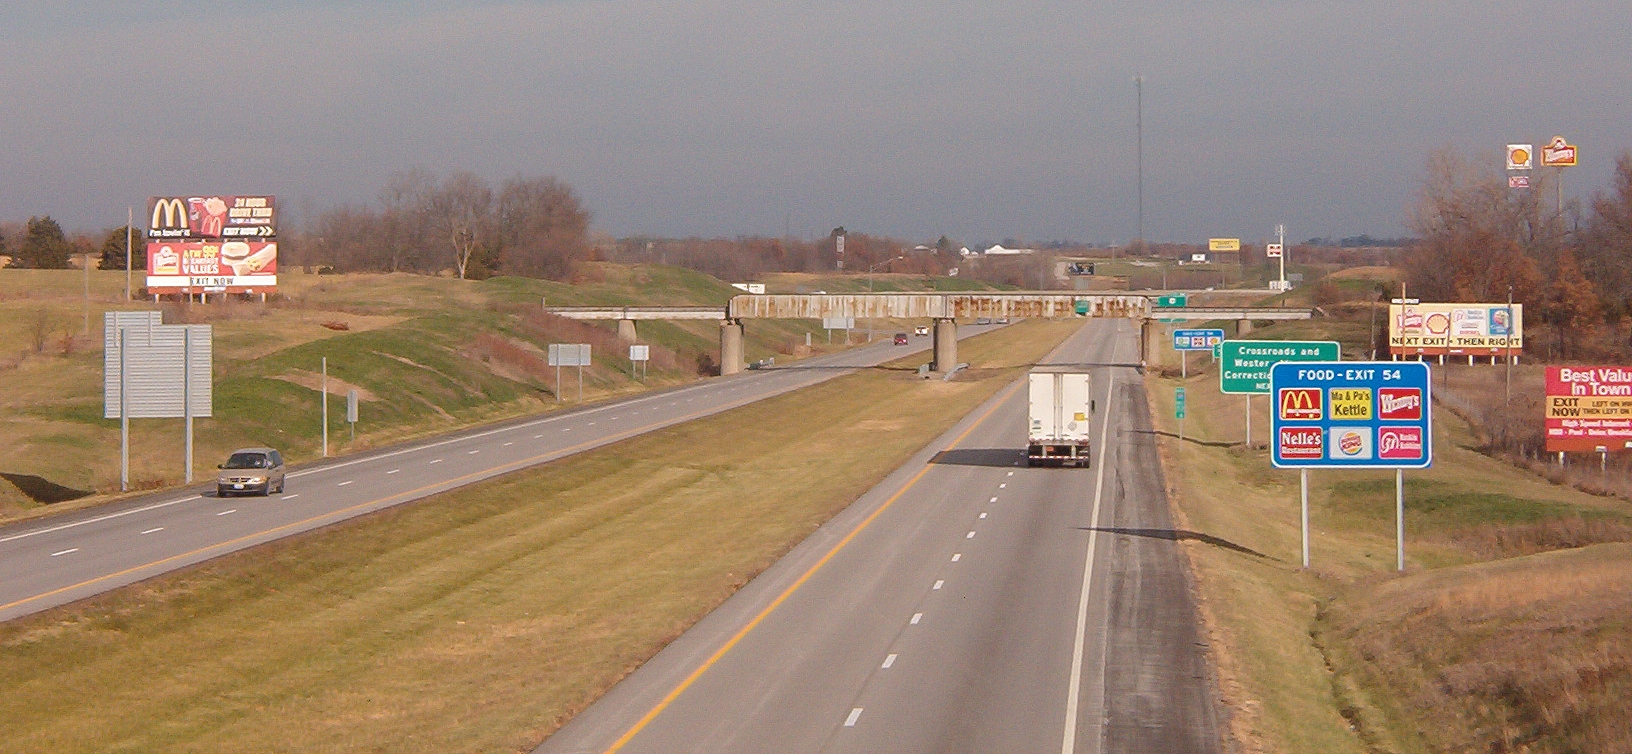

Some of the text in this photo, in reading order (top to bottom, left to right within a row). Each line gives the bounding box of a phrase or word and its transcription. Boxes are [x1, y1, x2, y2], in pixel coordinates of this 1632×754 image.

[182, 264, 219, 274] VALUES
[191, 277, 234, 285] EXIT NOW
[1422, 337, 1446, 345] EXIT
[1457, 337, 1485, 345] THEN
[1238, 346, 1320, 356] Crossroads and
[1234, 359, 1272, 367] Wester
[1298, 369, 1334, 381] FOOD
[1345, 369, 1375, 381] EXIT
[1382, 369, 1401, 381] 54
[1560, 368, 1595, 382] Best
[1571, 382, 1631, 395] In Town
[1331, 391, 1370, 401] Ma & Pa's
[1553, 397, 1579, 407] EXIT
[1334, 404, 1367, 416] Kettle
[1552, 407, 1580, 416] NOW
[1281, 432, 1322, 445] Nelle's
